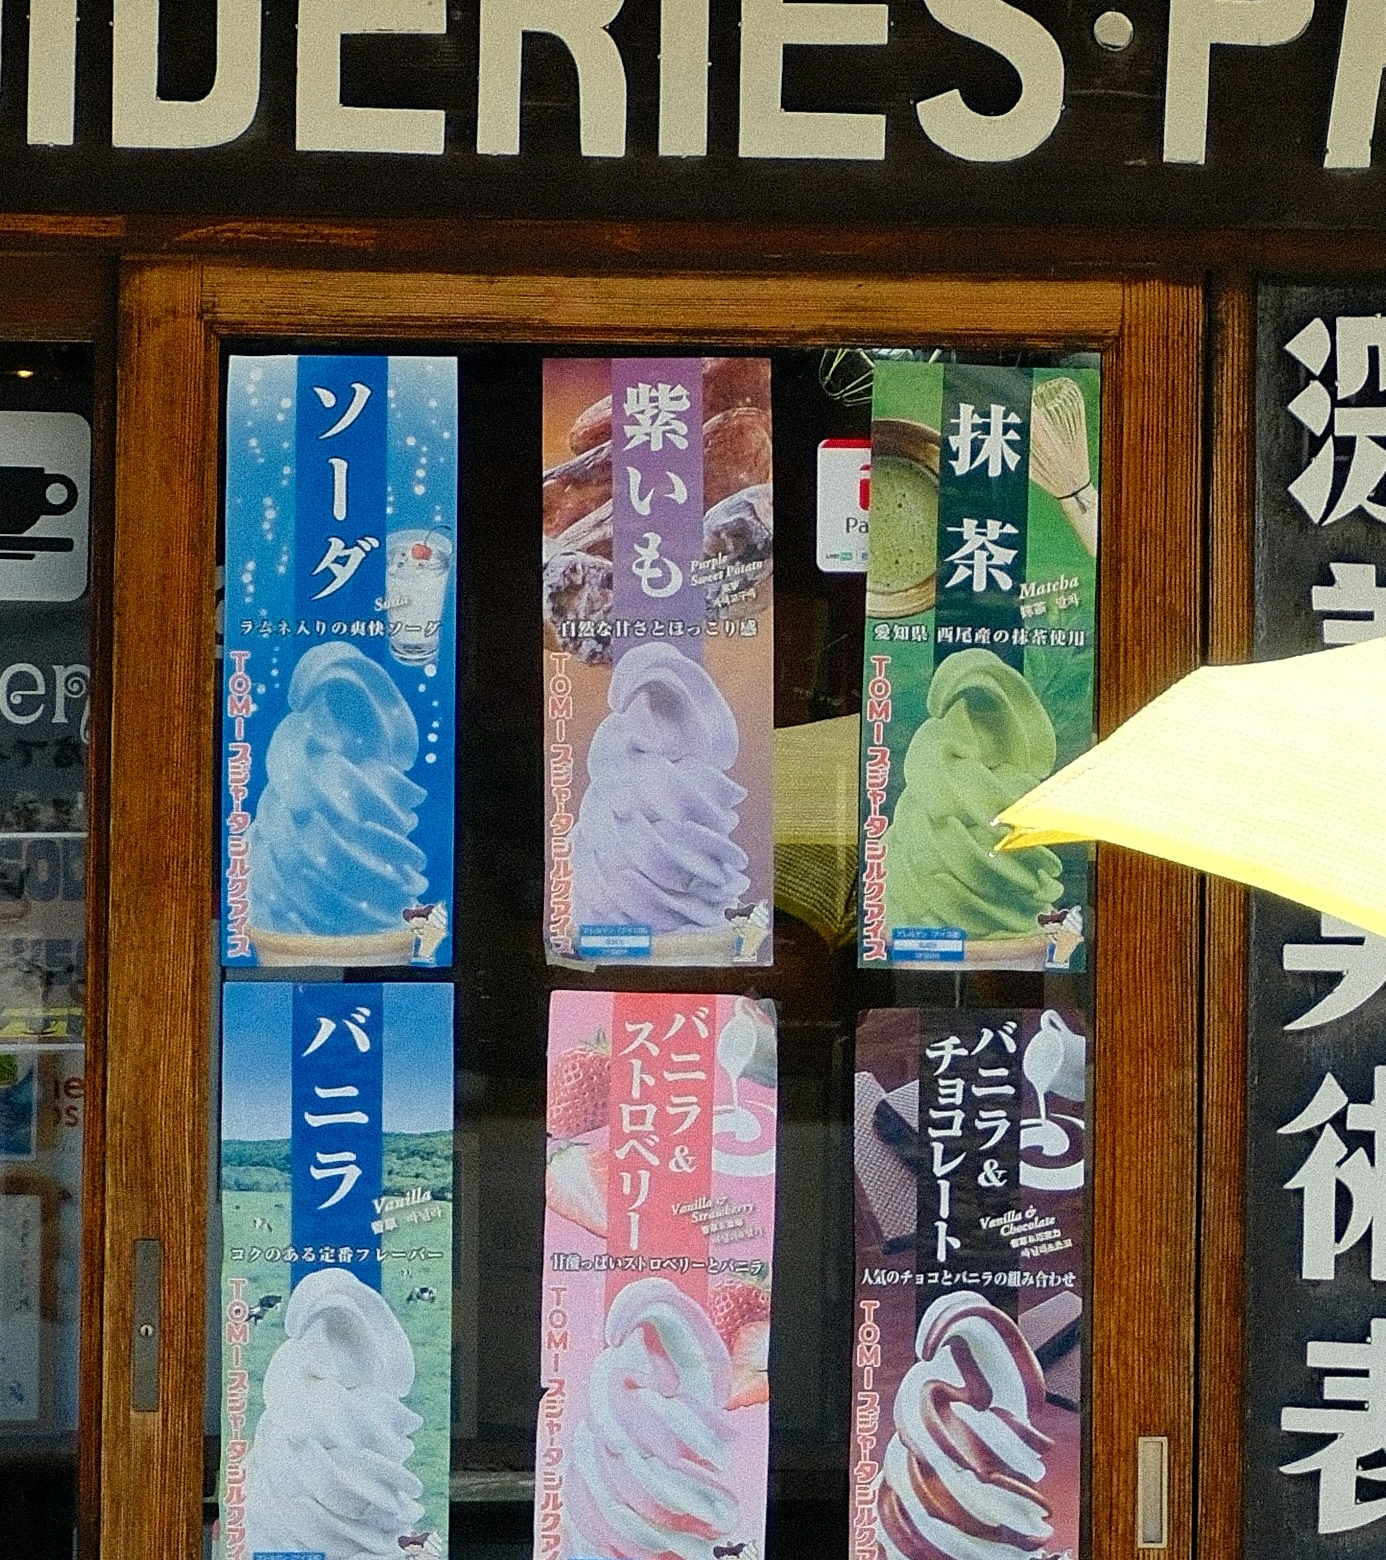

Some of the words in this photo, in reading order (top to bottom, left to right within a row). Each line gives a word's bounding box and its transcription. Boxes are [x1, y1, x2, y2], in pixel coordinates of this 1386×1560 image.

[311, 381, 381, 601] ソーダ
[622, 382, 691, 599] 紫いも
[944, 402, 1023, 593] 抹茶
[560, 619, 759, 638] 自然な甘さとほっこり感
[873, 623, 928, 643] 愛知県
[936, 627, 1086, 649] 西尾産の抹茶使用
[1018, 574, 1080, 600] Matcha
[301, 1005, 372, 1212] バニラ
[613, 1020, 662, 1252] ストロベリー
[663, 1010, 711, 1175] バニラ&
[925, 1035, 968, 1263] チョコレート
[970, 1020, 1019, 1188] バニラ&
[230, 1245, 445, 1265] コクのある定番フレーバー
[372, 1186, 433, 1215] Vanilla
[861, 1267, 1077, 1290] 人気のチョコとバニラの組み合わせ
